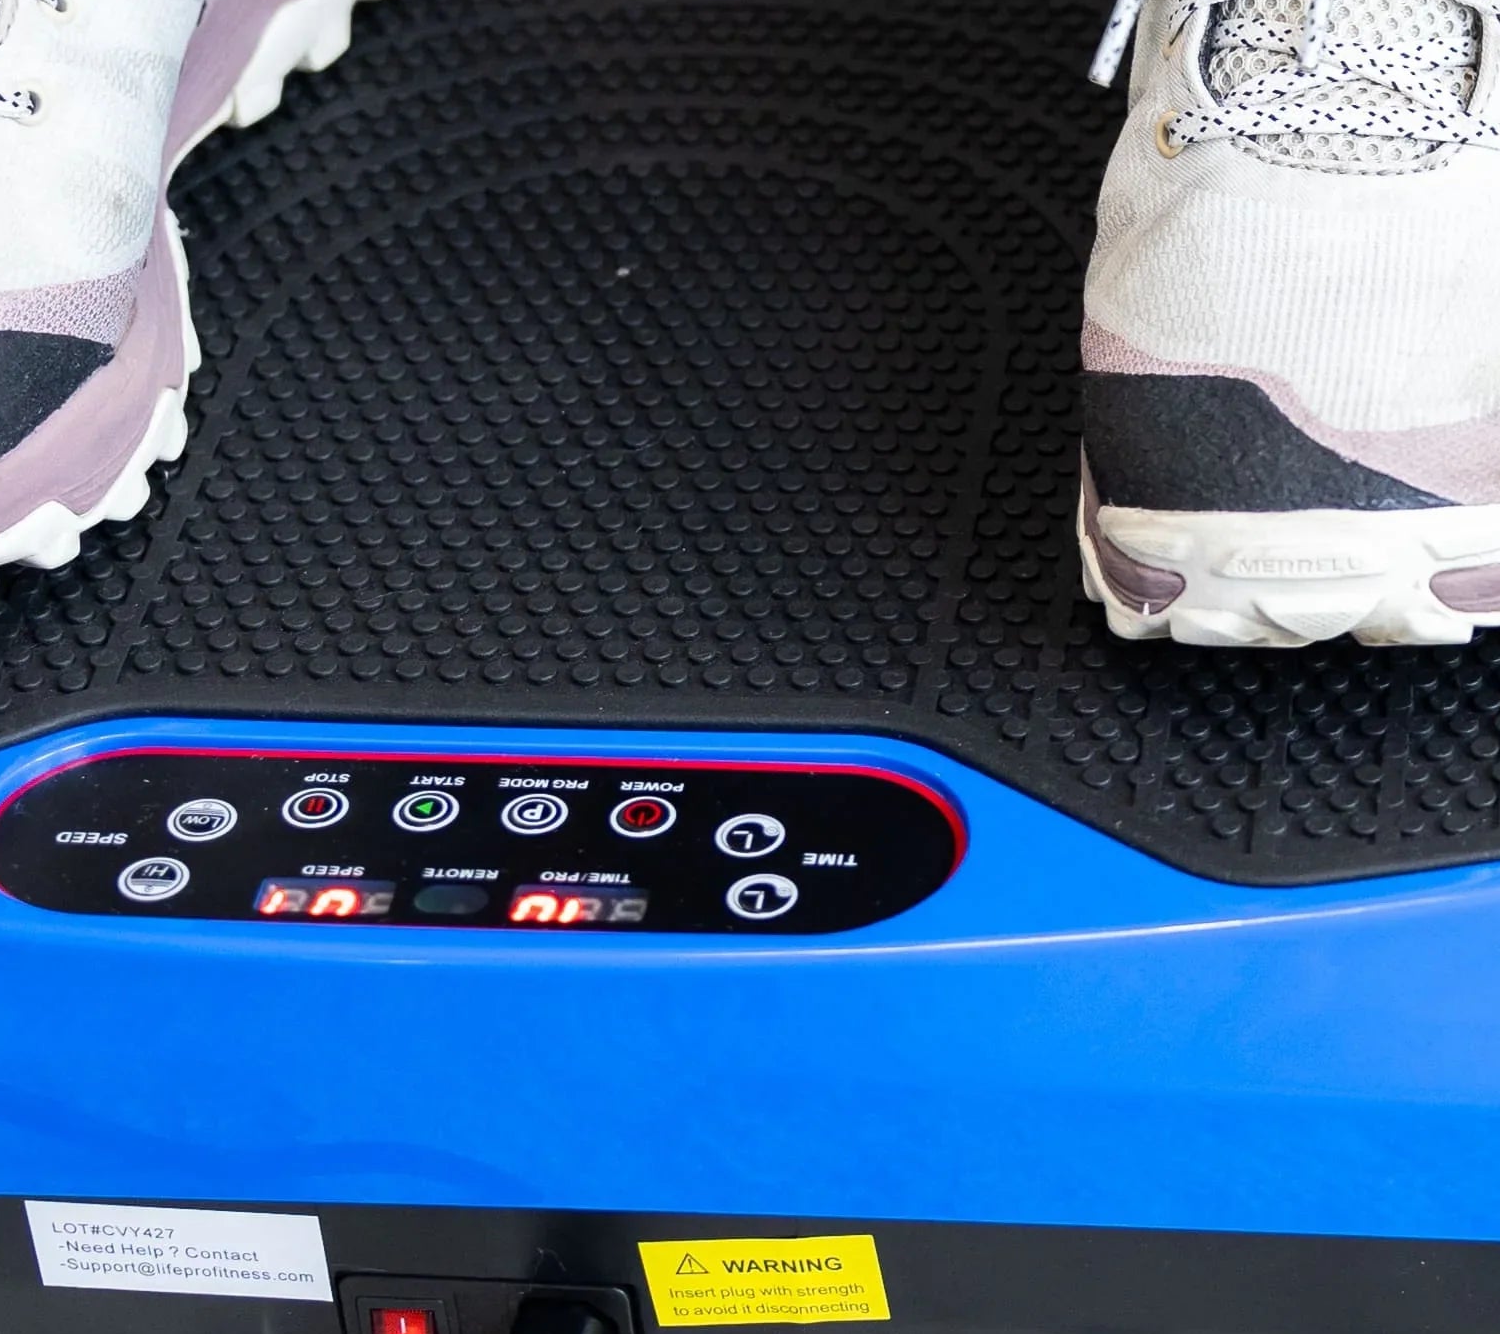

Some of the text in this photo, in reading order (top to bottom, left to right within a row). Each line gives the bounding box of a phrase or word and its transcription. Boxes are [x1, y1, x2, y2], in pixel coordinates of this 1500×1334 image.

[303, 772, 351, 784] STOP
[409, 774, 466, 786] START
[498, 777, 590, 790] PRG MODE
[619, 780, 685, 793] POWER
[180, 812, 224, 829] Low
[55, 831, 129, 845] SPEED
[801, 851, 859, 866] TIME
[141, 864, 168, 879] Hi
[301, 864, 365, 878] SPEED
[421, 867, 500, 880] REMOTE
[539, 871, 632, 885] TIME/PRO
[51, 1221, 175, 1240] LOT#CVY427
[120, 1243, 165, 1259] Help
[185, 1246, 260, 1263] Contact
[722, 1256, 843, 1274] WARNING
[669, 1282, 865, 1300] Insert plug with strength
[673, 1300, 870, 1317] to avoid it disconnecting
